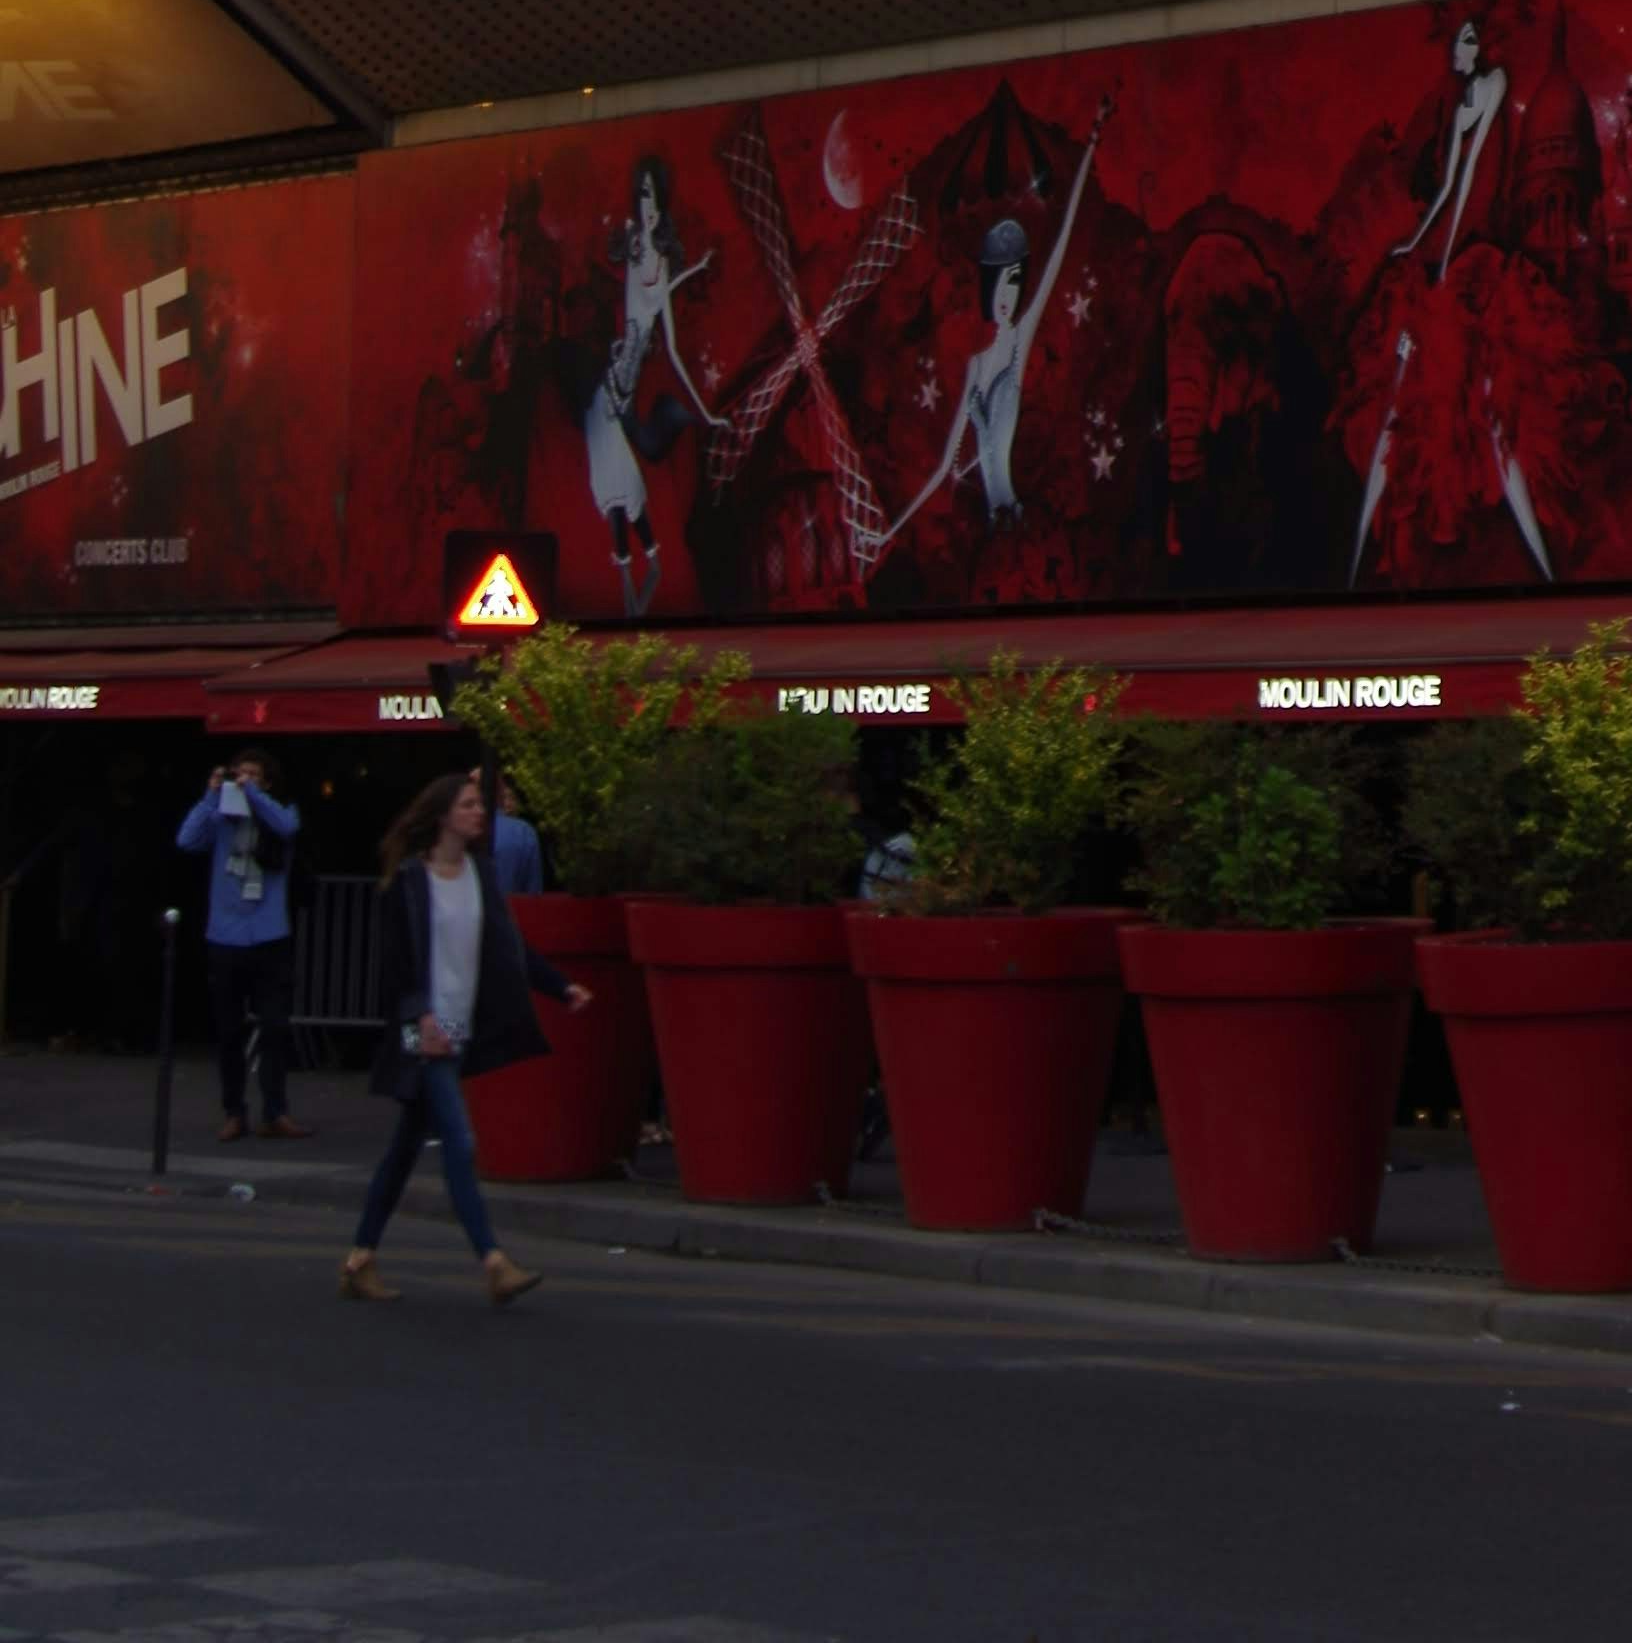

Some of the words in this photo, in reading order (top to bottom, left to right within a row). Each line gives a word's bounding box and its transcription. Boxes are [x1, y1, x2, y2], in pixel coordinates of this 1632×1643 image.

[0, 267, 193, 474] HINE
[47, 685, 100, 709] ROUGE
[857, 684, 931, 713] ROUGE
[1259, 679, 1350, 708] MOULIN
[1354, 675, 1442, 708] ROUGE
